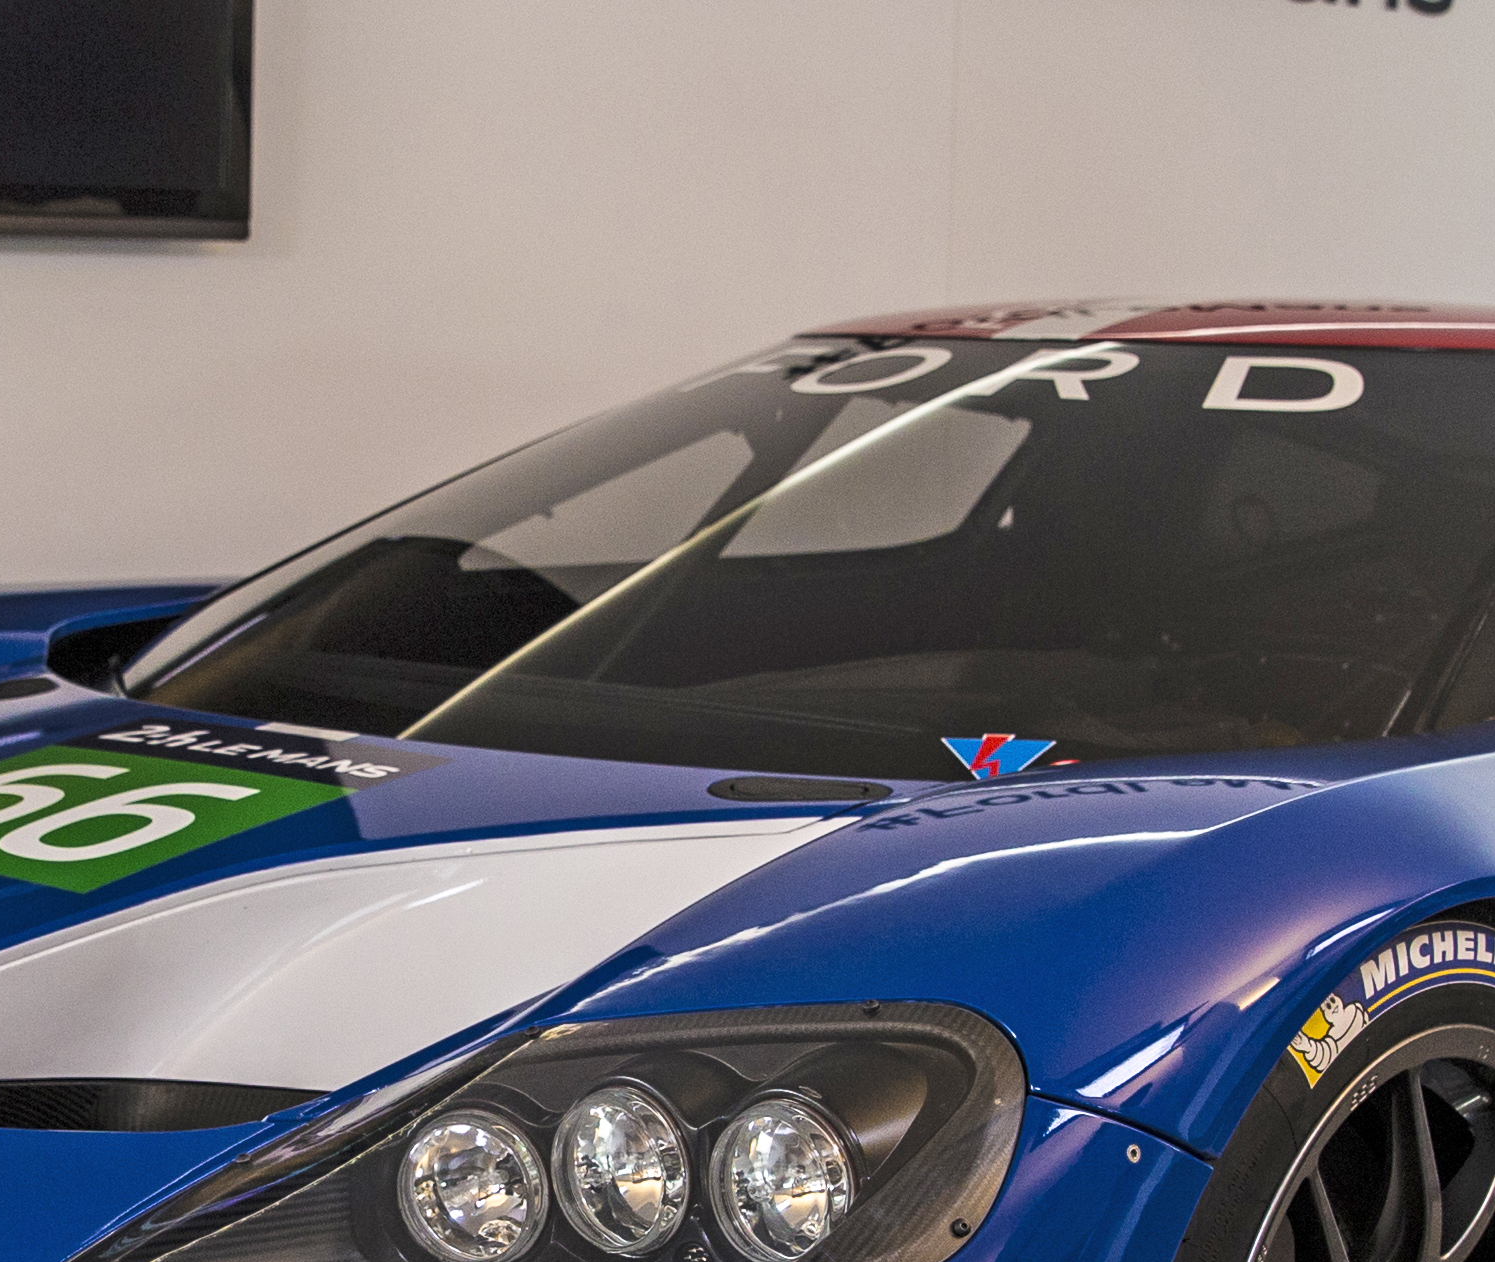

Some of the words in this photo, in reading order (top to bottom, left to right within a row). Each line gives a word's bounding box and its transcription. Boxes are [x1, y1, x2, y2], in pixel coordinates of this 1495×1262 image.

[689, 345, 1365, 412] FORD
[187, 740, 263, 756] LE
[247, 749, 400, 779] MANS
